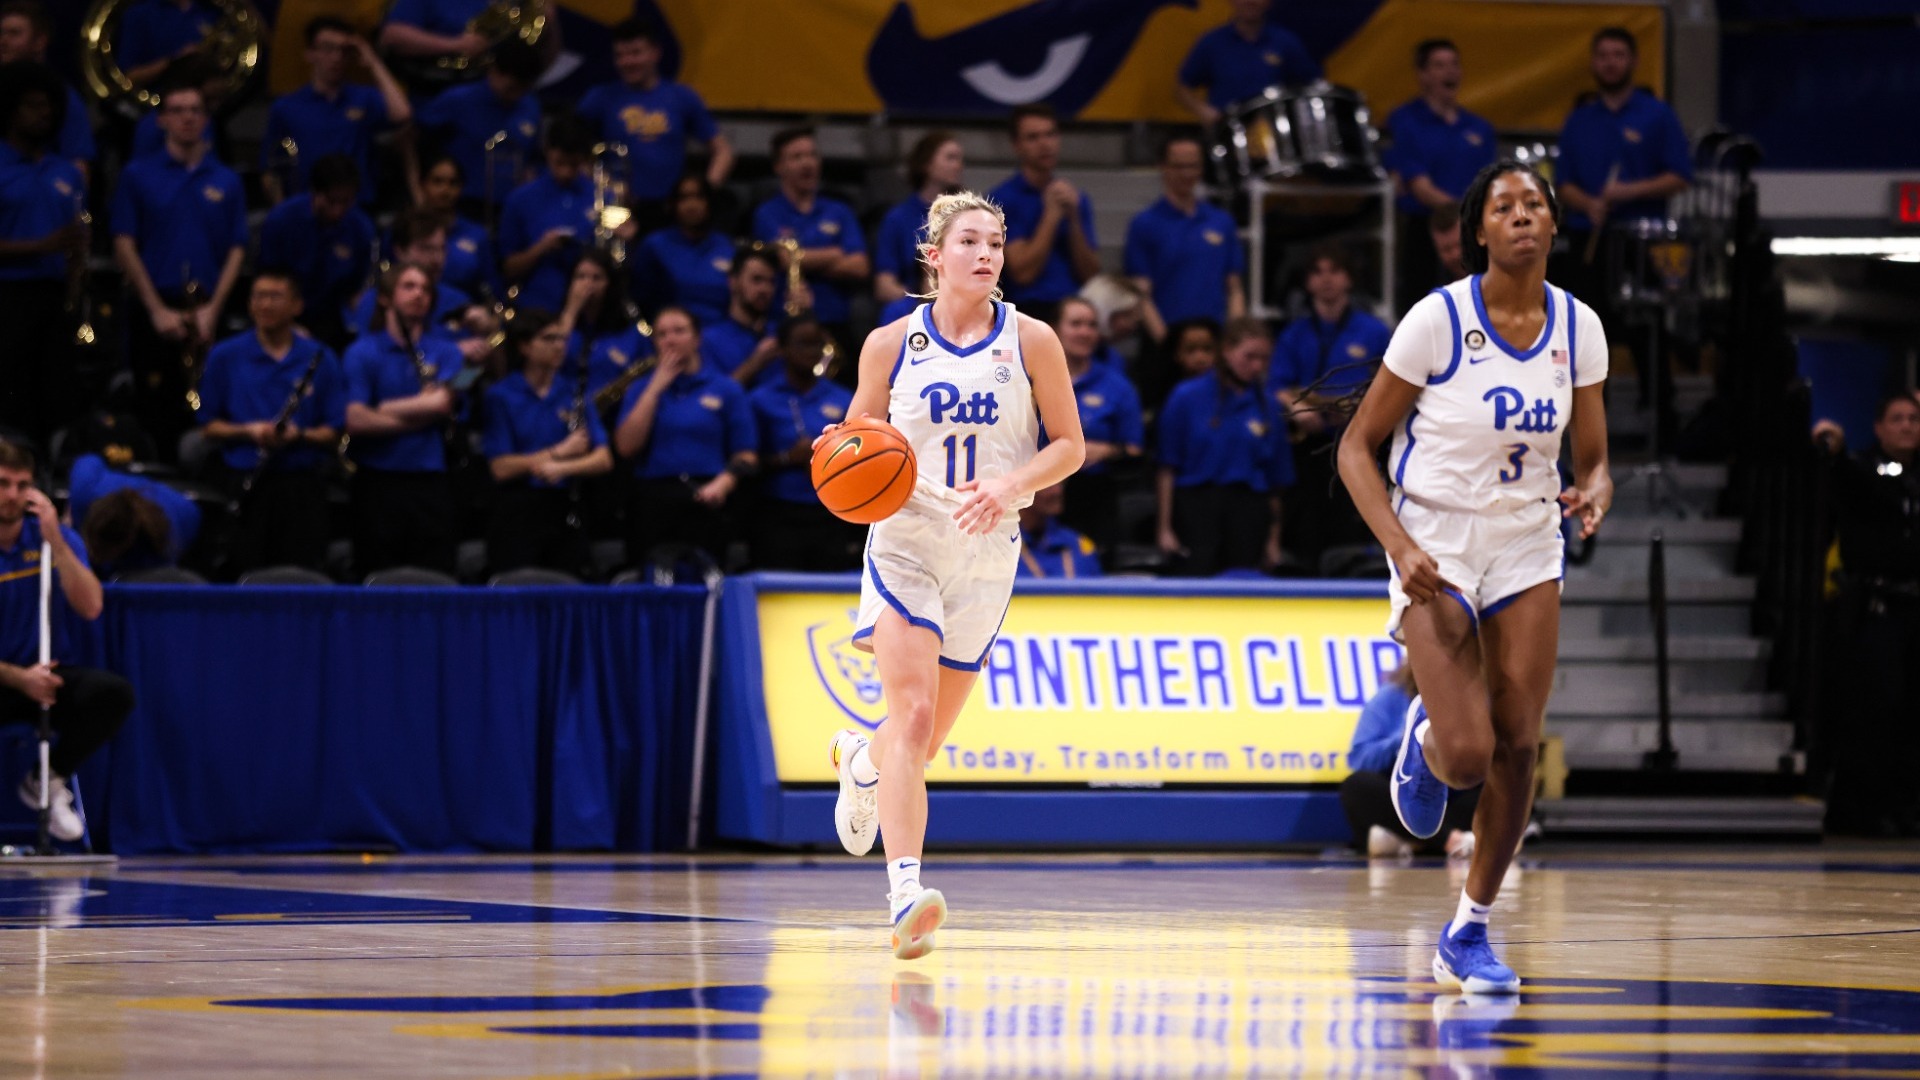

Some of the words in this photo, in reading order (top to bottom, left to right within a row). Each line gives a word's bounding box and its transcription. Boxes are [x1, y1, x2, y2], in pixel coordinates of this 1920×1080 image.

[919, 381, 999, 426] Pitt
[1482, 386, 1558, 433] Pitt
[943, 432, 977, 488] 11
[1499, 442, 1530, 484] 3
[986, 638, 1231, 706] ANTHER
[943, 745, 1045, 774] Today.
[1058, 745, 1229, 771] Transform
[1241, 745, 1347, 771] Tomor
